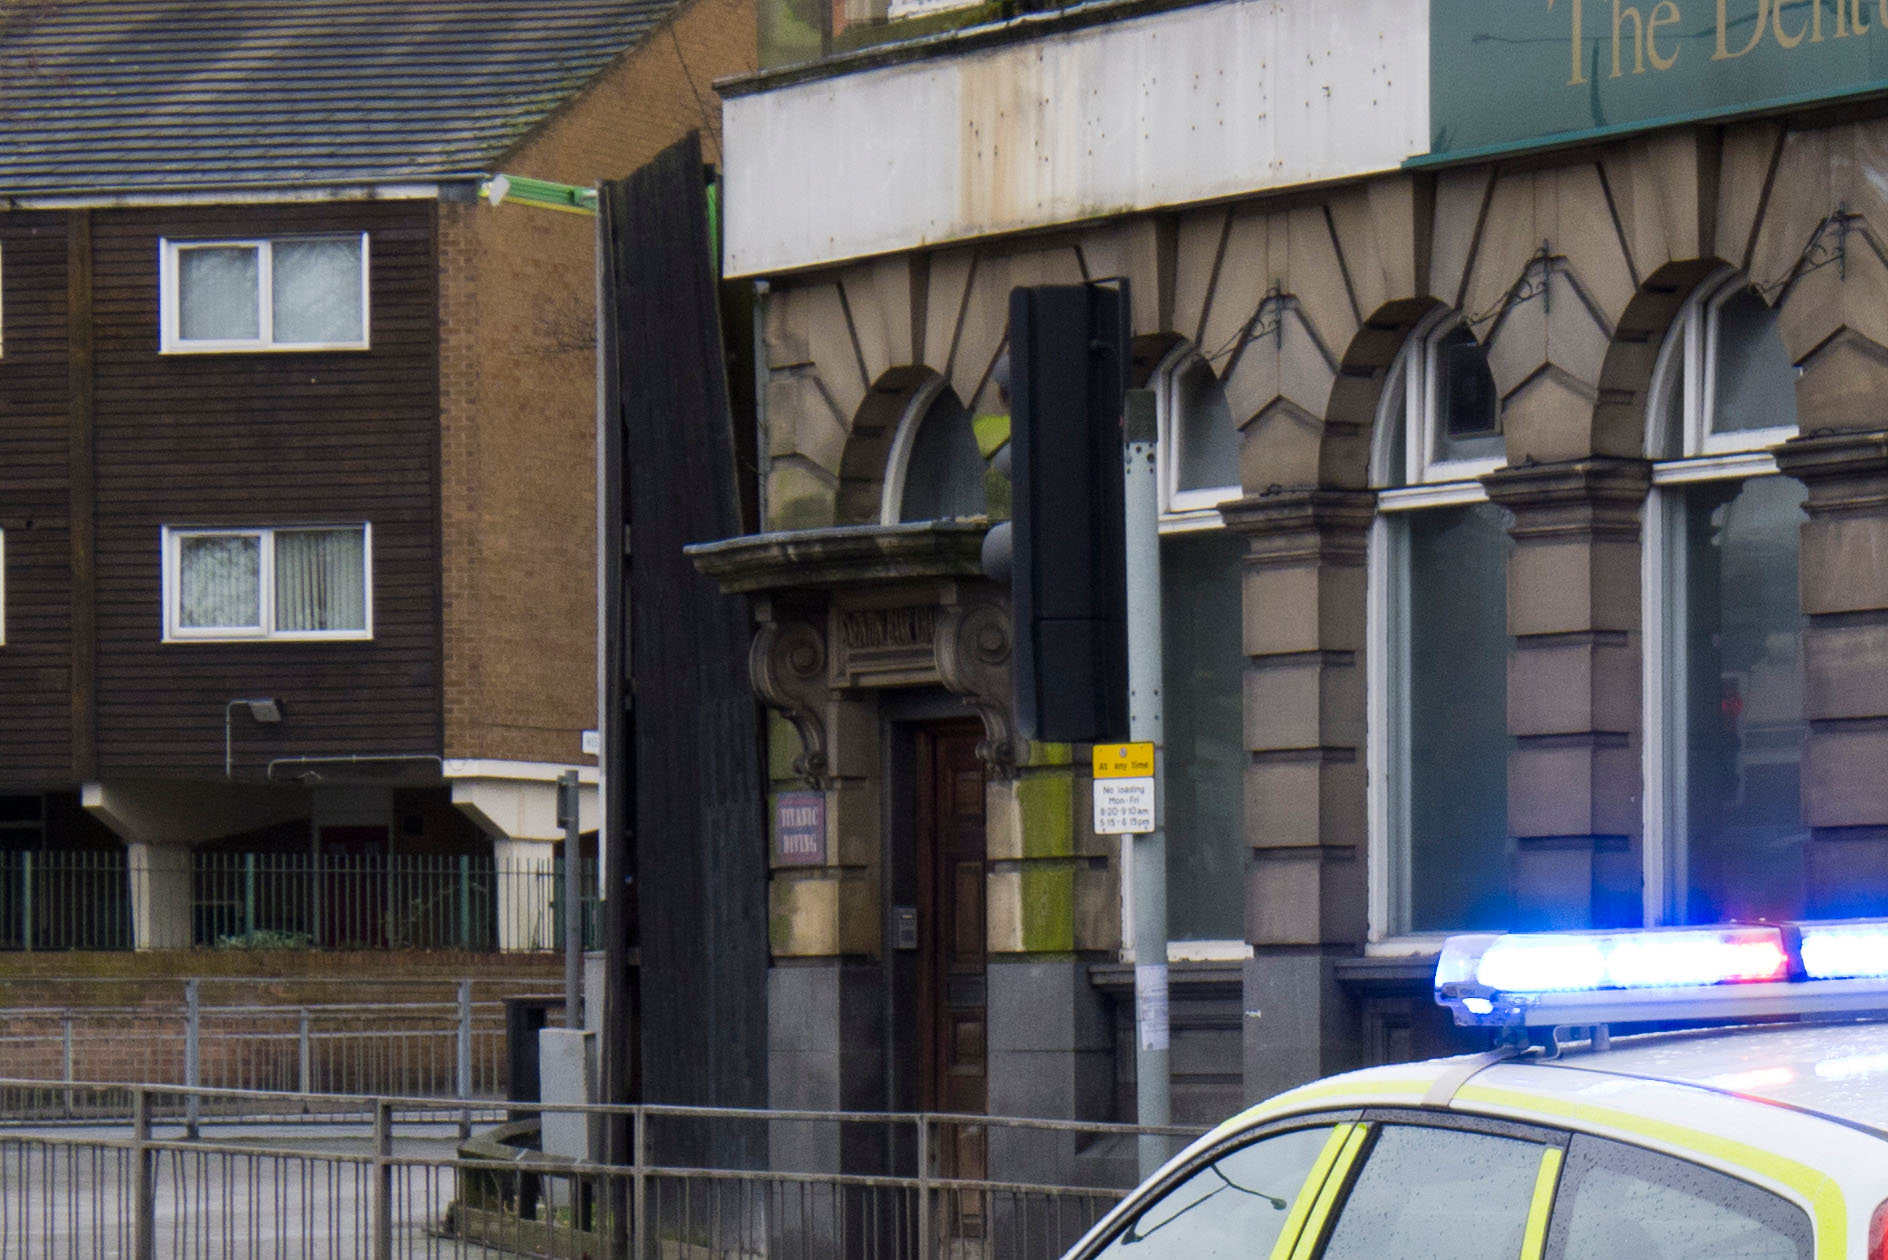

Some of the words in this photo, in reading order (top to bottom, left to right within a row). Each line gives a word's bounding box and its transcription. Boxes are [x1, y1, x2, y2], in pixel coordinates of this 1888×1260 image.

[1547, 0, 1681, 85] The
[1114, 762, 1128, 771] any
[1131, 761, 1149, 769] time
[1103, 786, 1114, 795] No
[1118, 785, 1145, 795] loading
